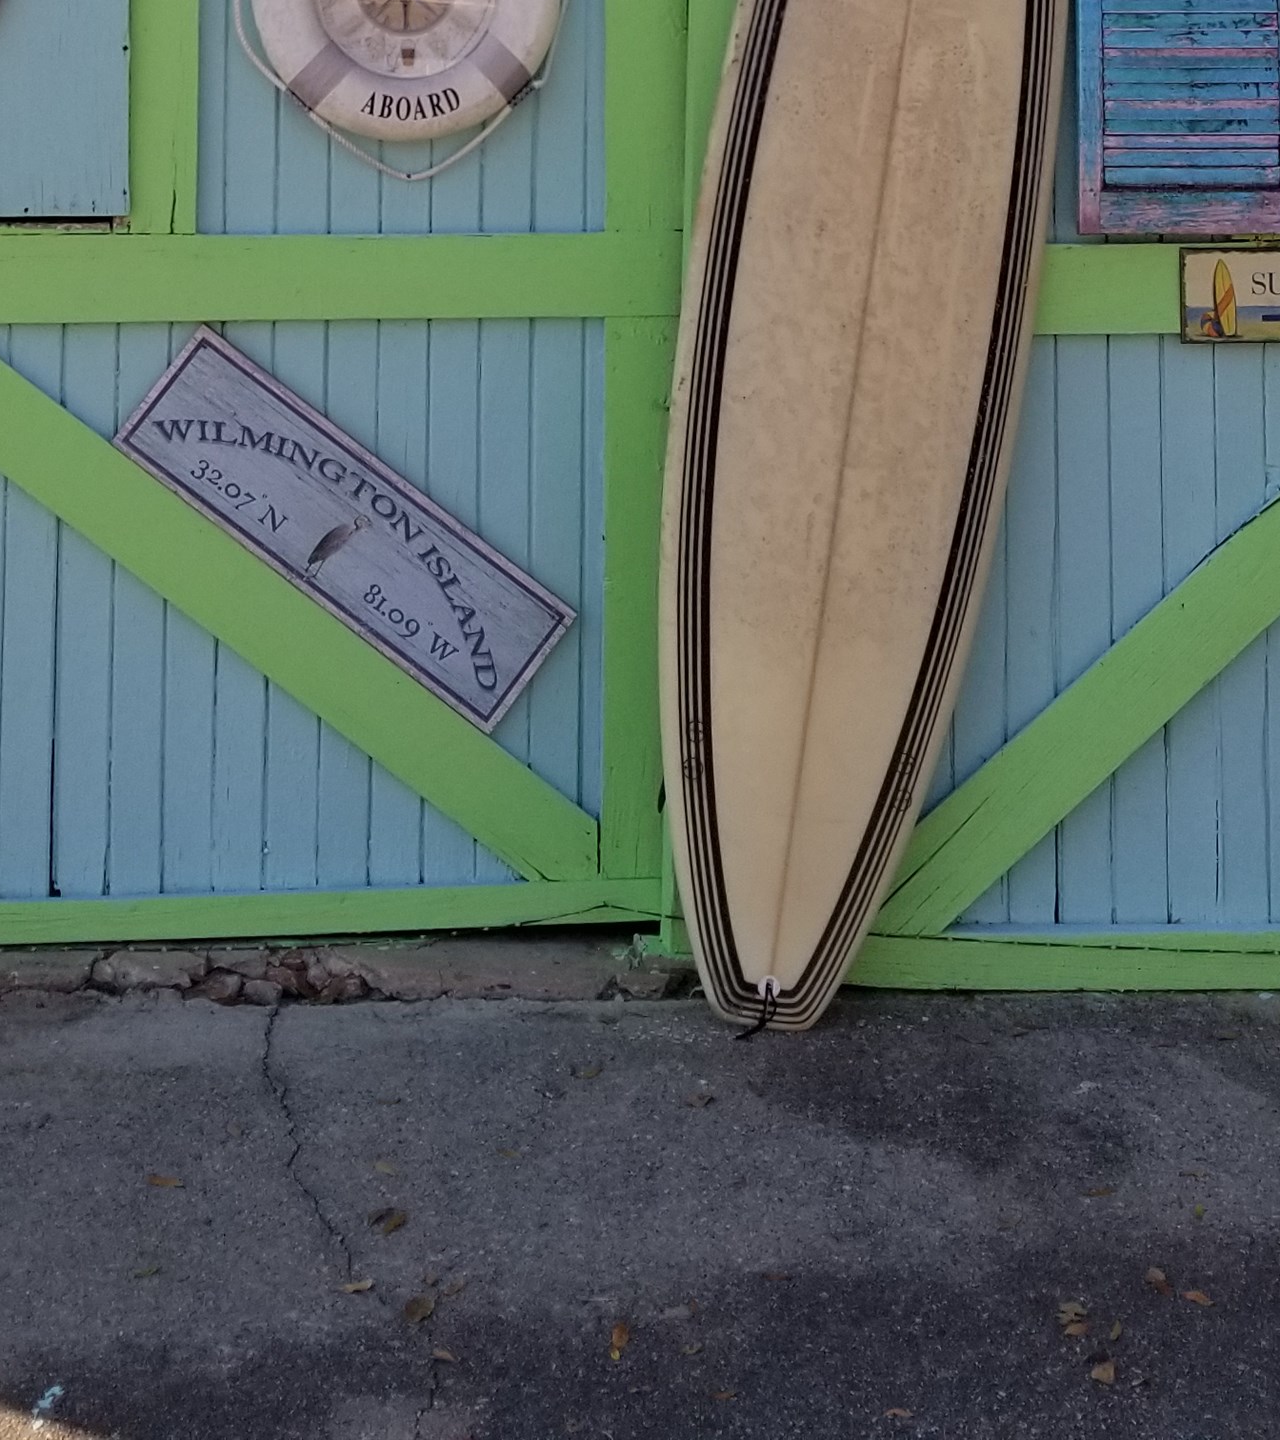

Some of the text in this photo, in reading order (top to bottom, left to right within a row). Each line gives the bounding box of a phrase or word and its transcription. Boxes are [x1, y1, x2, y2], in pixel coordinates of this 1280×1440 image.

[360, 86, 460, 121] ABOARD
[257, 503, 289, 534] N
[153, 417, 498, 693] WILMINGTON ISLAND
[429, 630, 460, 661] W
